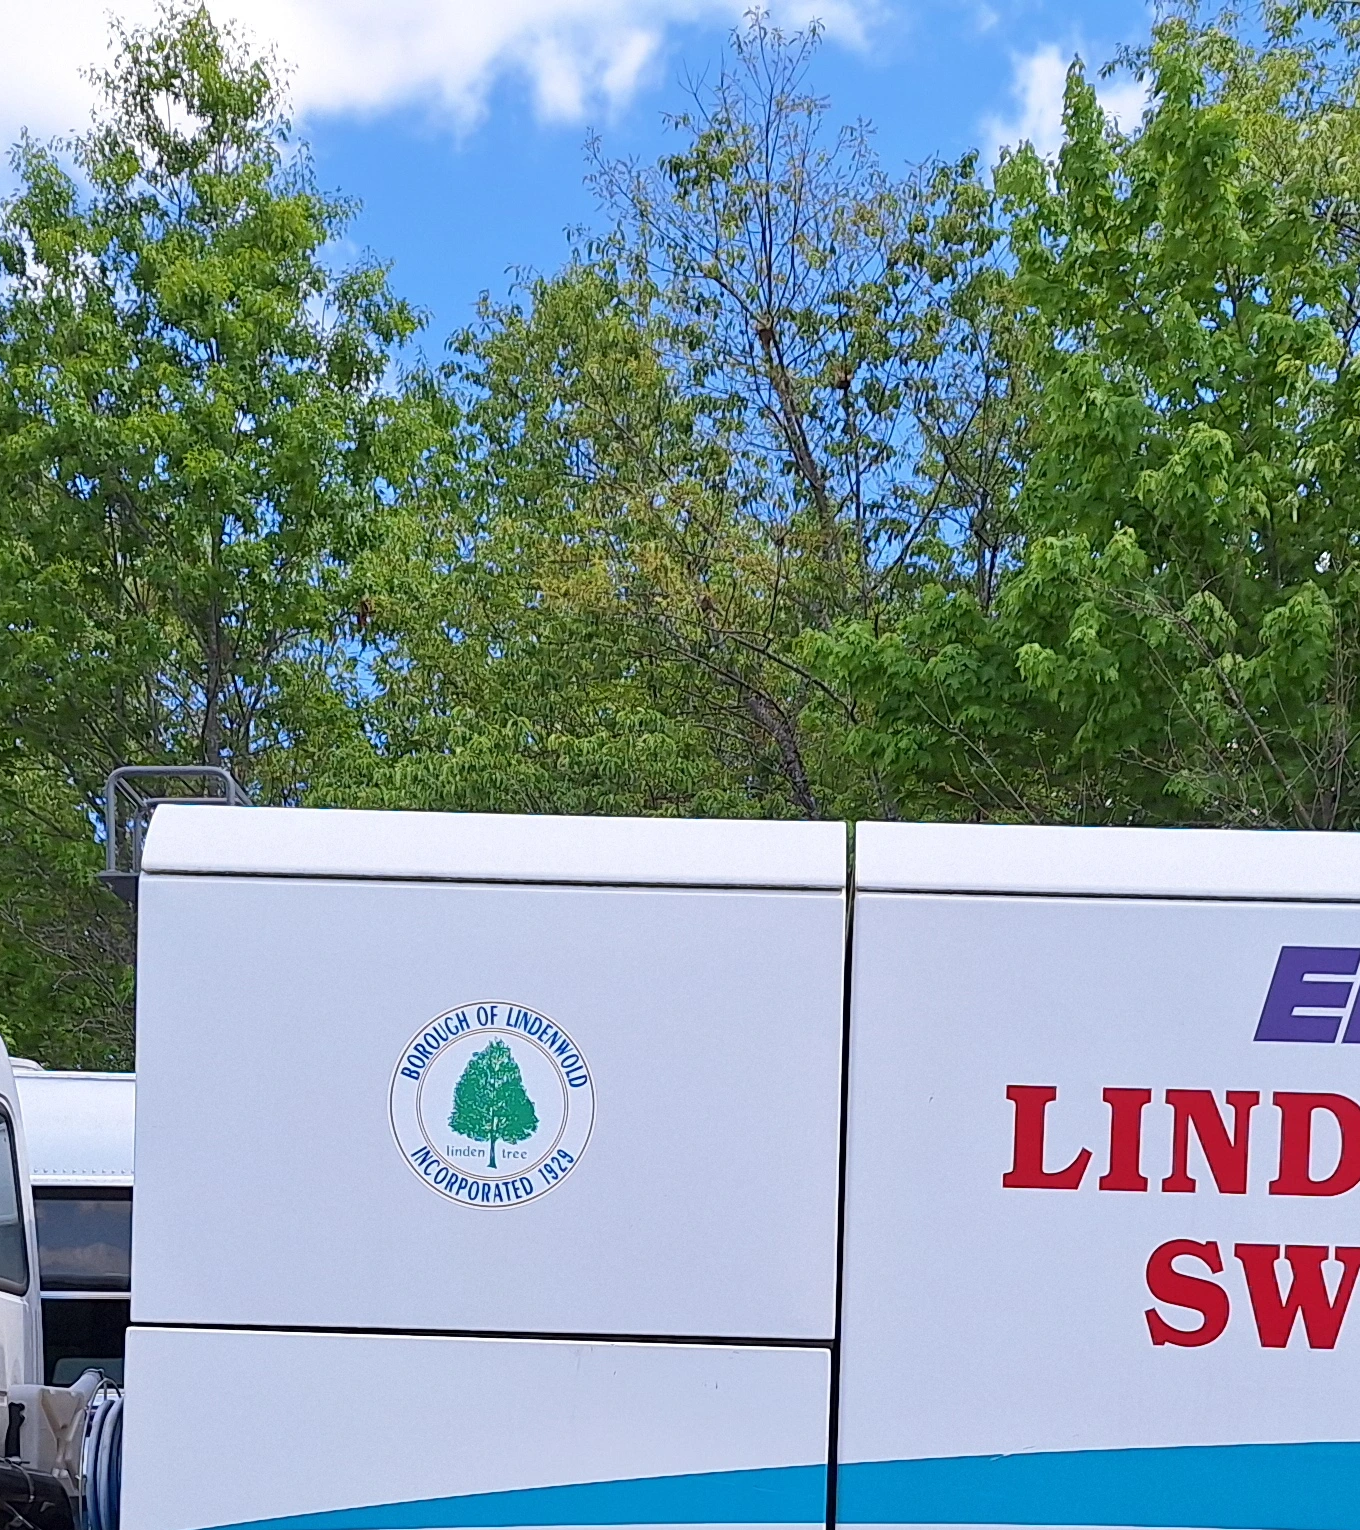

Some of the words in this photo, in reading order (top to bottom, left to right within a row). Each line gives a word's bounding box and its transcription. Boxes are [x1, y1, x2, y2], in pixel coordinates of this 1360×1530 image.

[401, 1010, 471, 1081] BOROUGH
[476, 1005, 498, 1026] OF
[506, 1007, 588, 1088] LINDENWOLD
[410, 1145, 533, 1203] INCORPORATED
[538, 1148, 574, 1185] 1929
[446, 1145, 485, 1158] linden
[502, 1148, 527, 1159] tree
